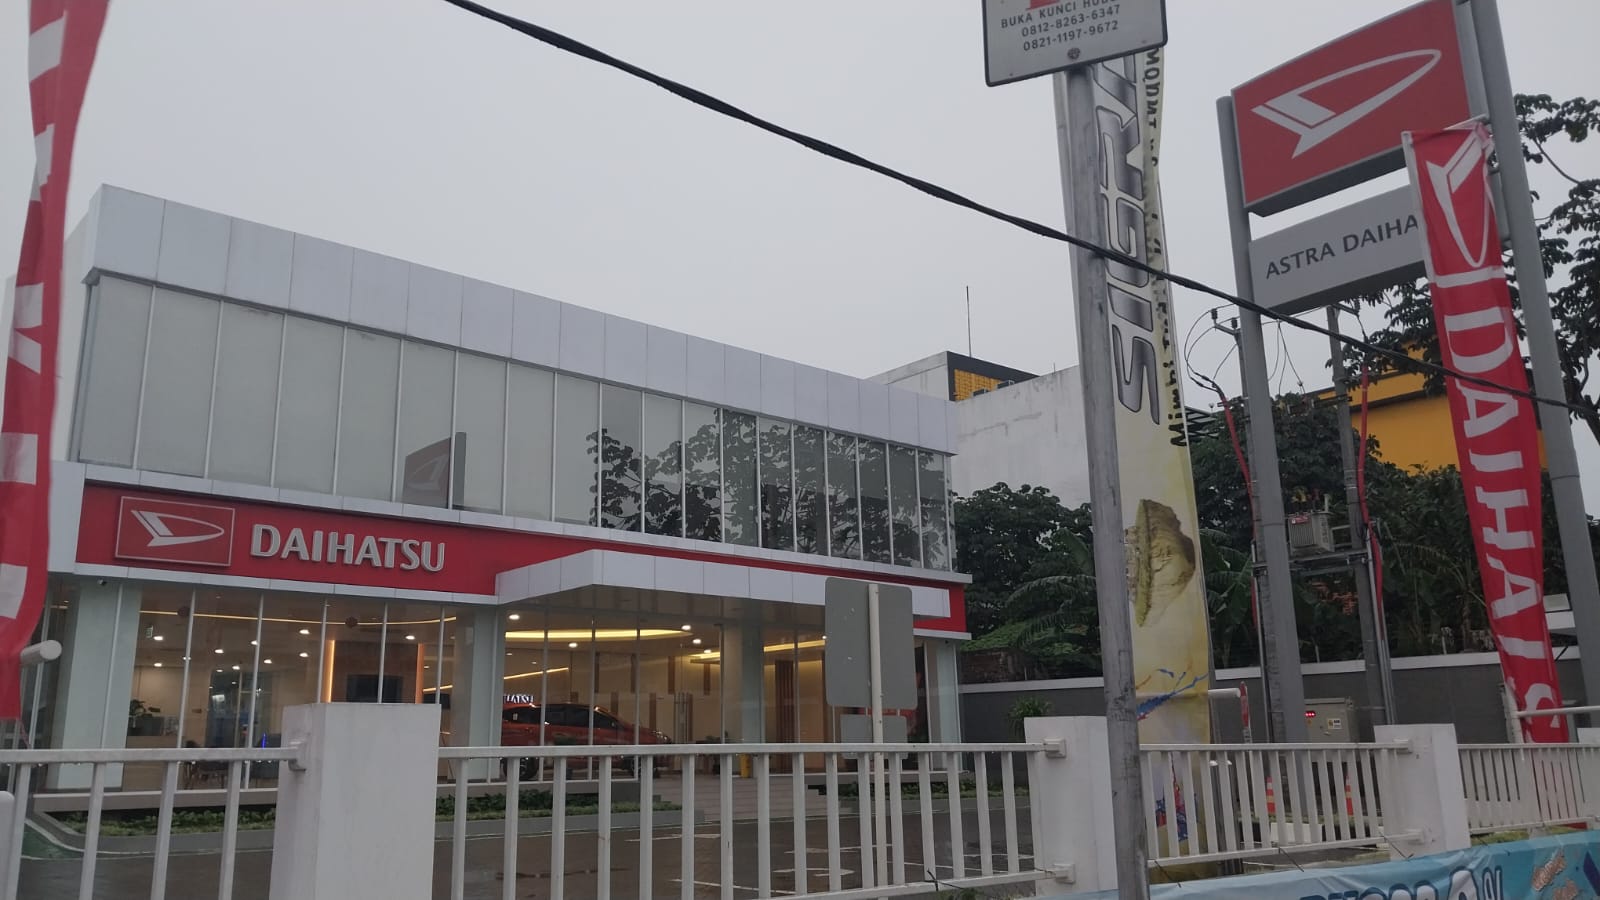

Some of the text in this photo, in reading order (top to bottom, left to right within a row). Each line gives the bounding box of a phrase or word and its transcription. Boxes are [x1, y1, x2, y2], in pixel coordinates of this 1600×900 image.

[1001, 12, 1032, 28] BUKA
[1039, 2, 1076, 19] KUNCI
[1021, 4, 1121, 37] 0812-8263-6347
[1023, 20, 1119, 51] 0821-1197-9672
[1265, 214, 1419, 280] ASTRA DAIHA
[1444, 306, 1561, 743] DAIHATS
[250, 523, 446, 572] DAIHATSU
